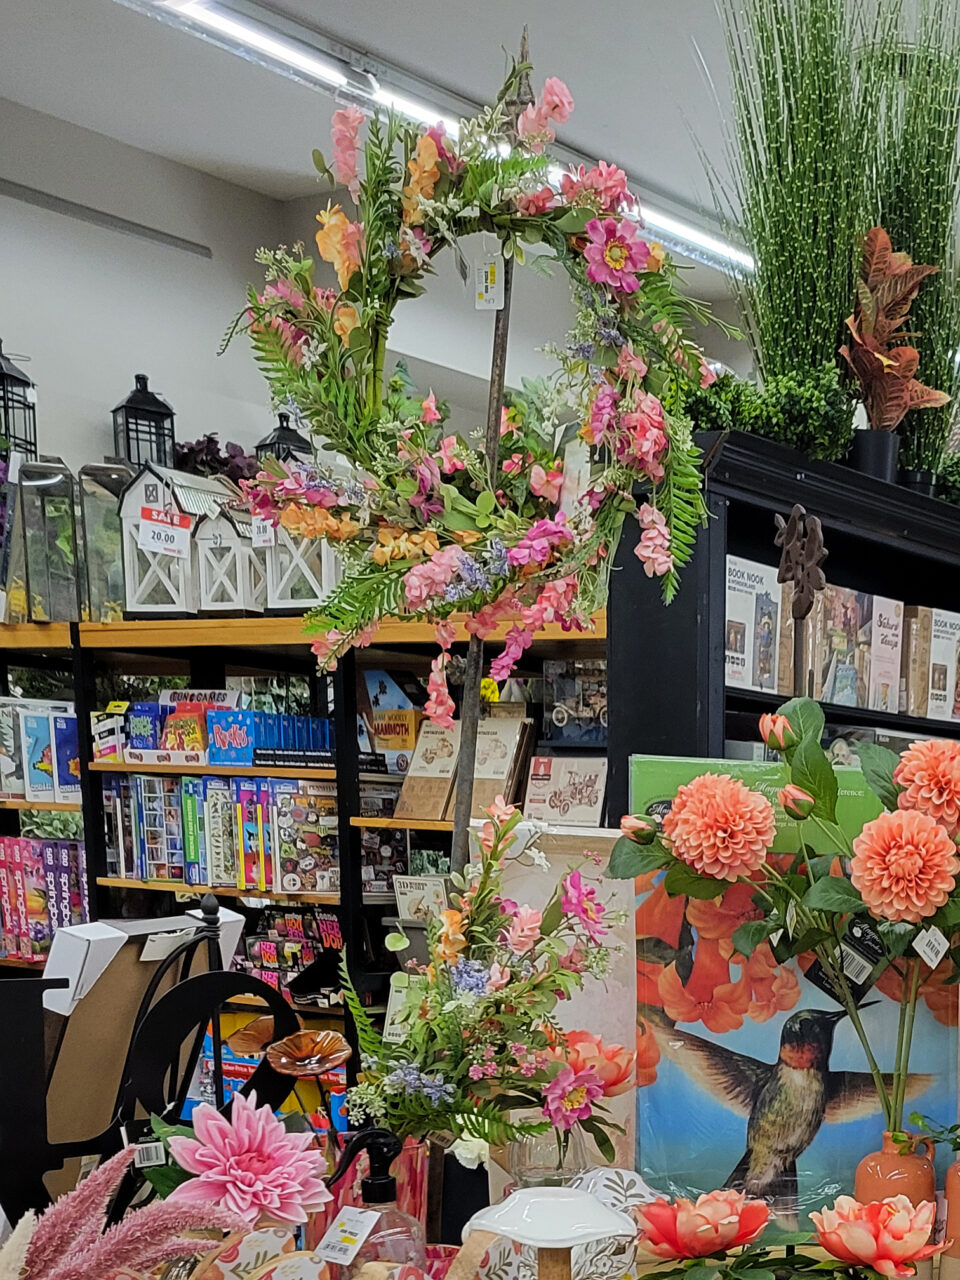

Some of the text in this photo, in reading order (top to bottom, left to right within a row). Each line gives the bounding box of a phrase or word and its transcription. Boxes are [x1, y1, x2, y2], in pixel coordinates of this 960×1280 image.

[151, 510, 181, 525] SALE
[151, 530, 176, 544] 20.00
[728, 567, 765, 586] BOOK NOOK
[933, 618, 948, 630] BOOK
[196, 691, 228, 703] GAMES
[374, 723, 410, 737] MAMMOTH
[46, 848, 58, 933] 500 springbo
[397, 880, 409, 889] 3D
[14, 871, 27, 933] springbok
[61, 873, 70, 928] springbo
